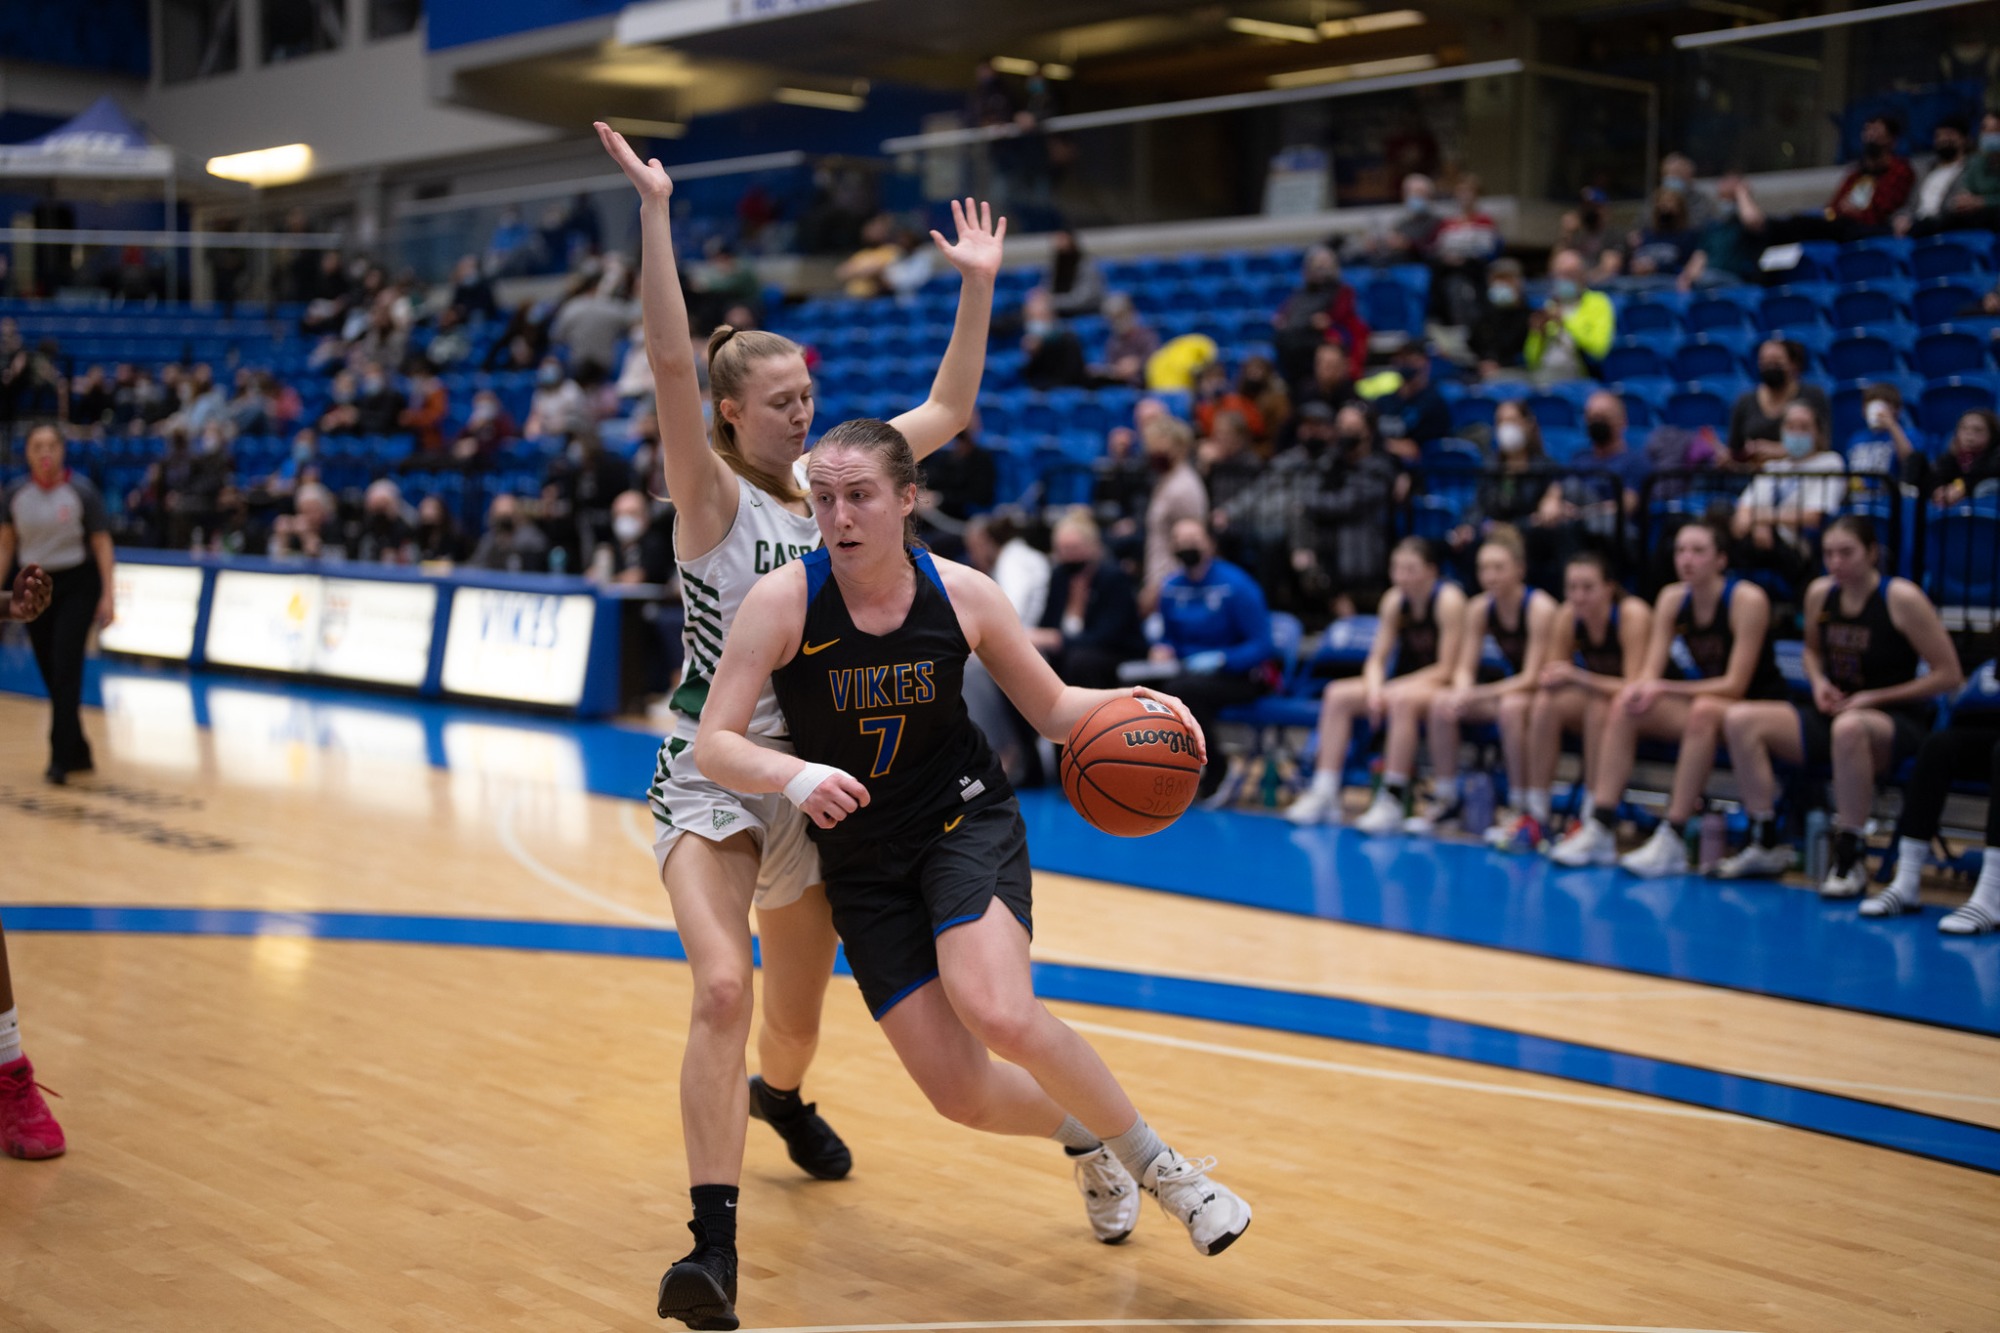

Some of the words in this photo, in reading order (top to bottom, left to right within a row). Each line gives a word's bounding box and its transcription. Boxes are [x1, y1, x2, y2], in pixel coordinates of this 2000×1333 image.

[828, 661, 936, 711] VIKES
[859, 715, 906, 778] 7
[1122, 728, 1200, 761] Wilson
[959, 776, 971, 787] M
